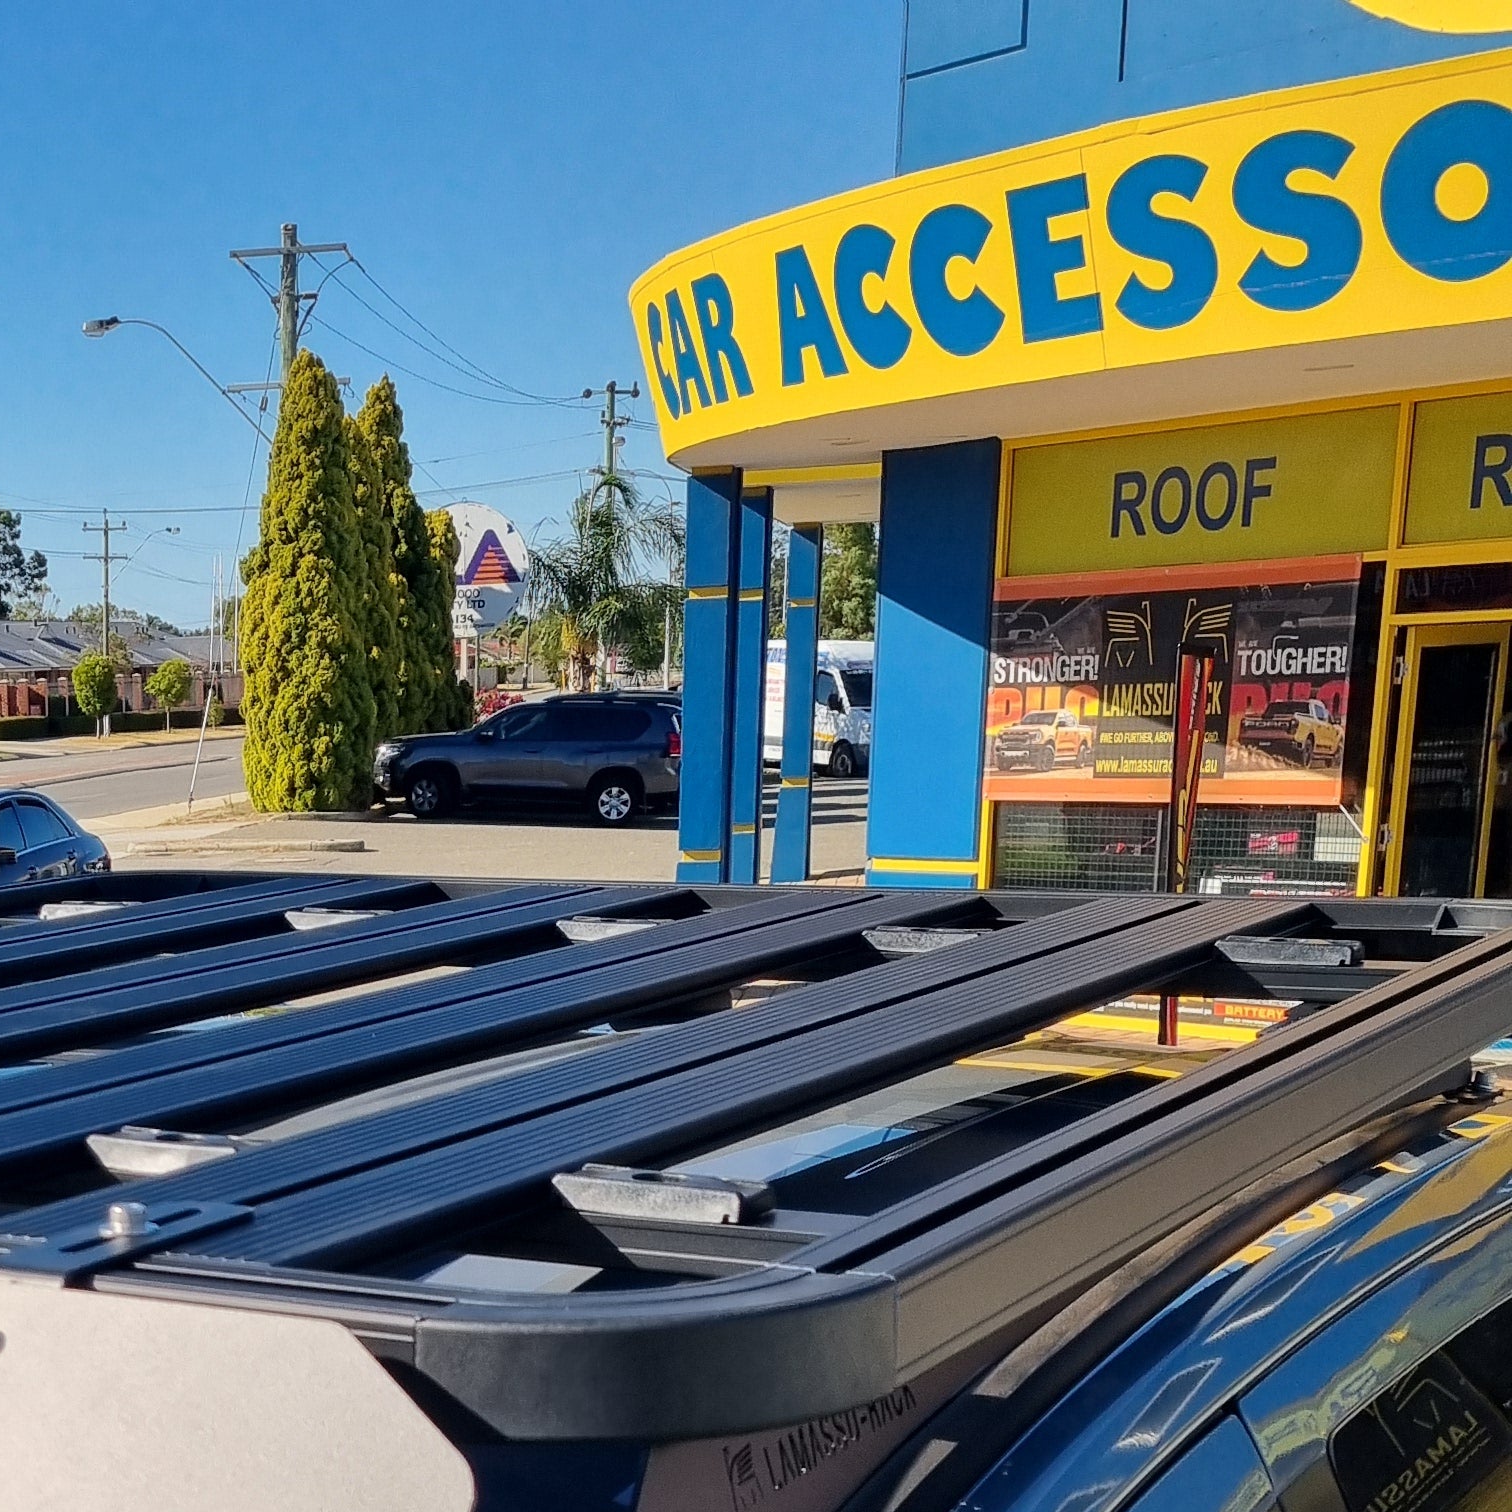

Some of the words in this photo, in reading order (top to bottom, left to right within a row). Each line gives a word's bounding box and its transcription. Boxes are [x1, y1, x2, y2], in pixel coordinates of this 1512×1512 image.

[646, 271, 755, 422] CAR
[773, 98, 1512, 388] ACCESSO
[1109, 455, 1278, 539] ROOF
[993, 654, 1100, 684] STRONGER!
[1237, 646, 1348, 676] TOUGHER!
[1224, 1004, 1286, 1020] BATTERY
